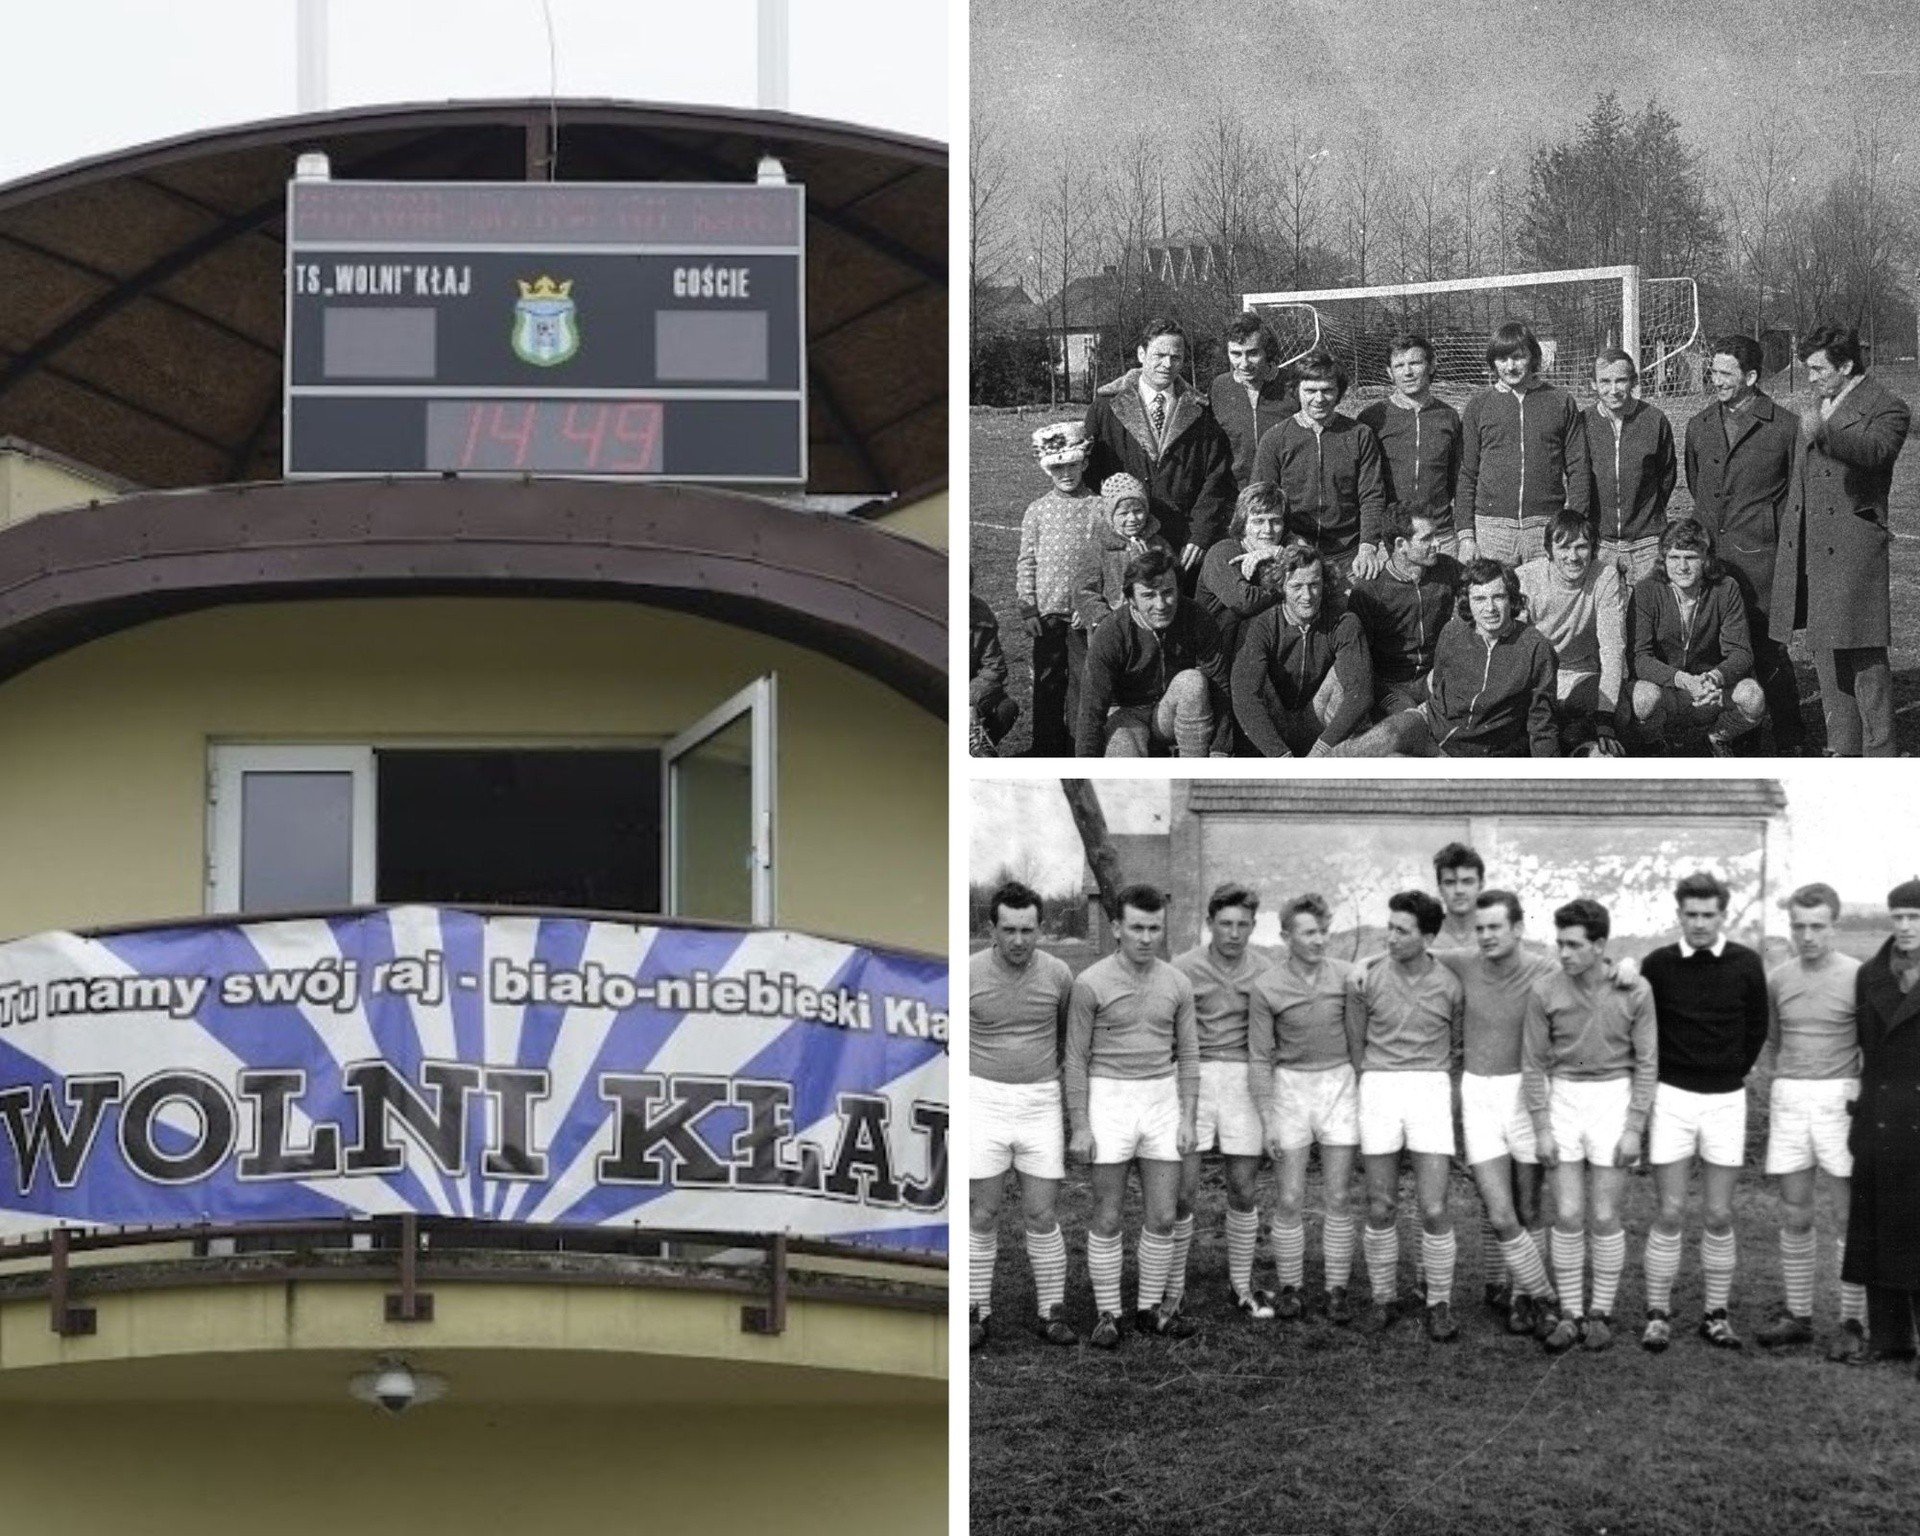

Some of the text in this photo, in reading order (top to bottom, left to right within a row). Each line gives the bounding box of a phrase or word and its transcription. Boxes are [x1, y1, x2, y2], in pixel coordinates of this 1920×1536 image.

[295, 264, 321, 295] TS
[414, 264, 472, 296] KŁAJ
[672, 263, 751, 298] GOŚCIE
[460, 402, 664, 472] 14 49
[0, 980, 38, 1027] Tu
[47, 970, 207, 1019] mamy
[218, 957, 357, 1013] swój
[371, 949, 443, 1006] raj
[489, 956, 872, 1031] biało-niebieski
[882, 993, 949, 1055] Kła
[0, 1059, 949, 1211] WOLNI KŁAJ
